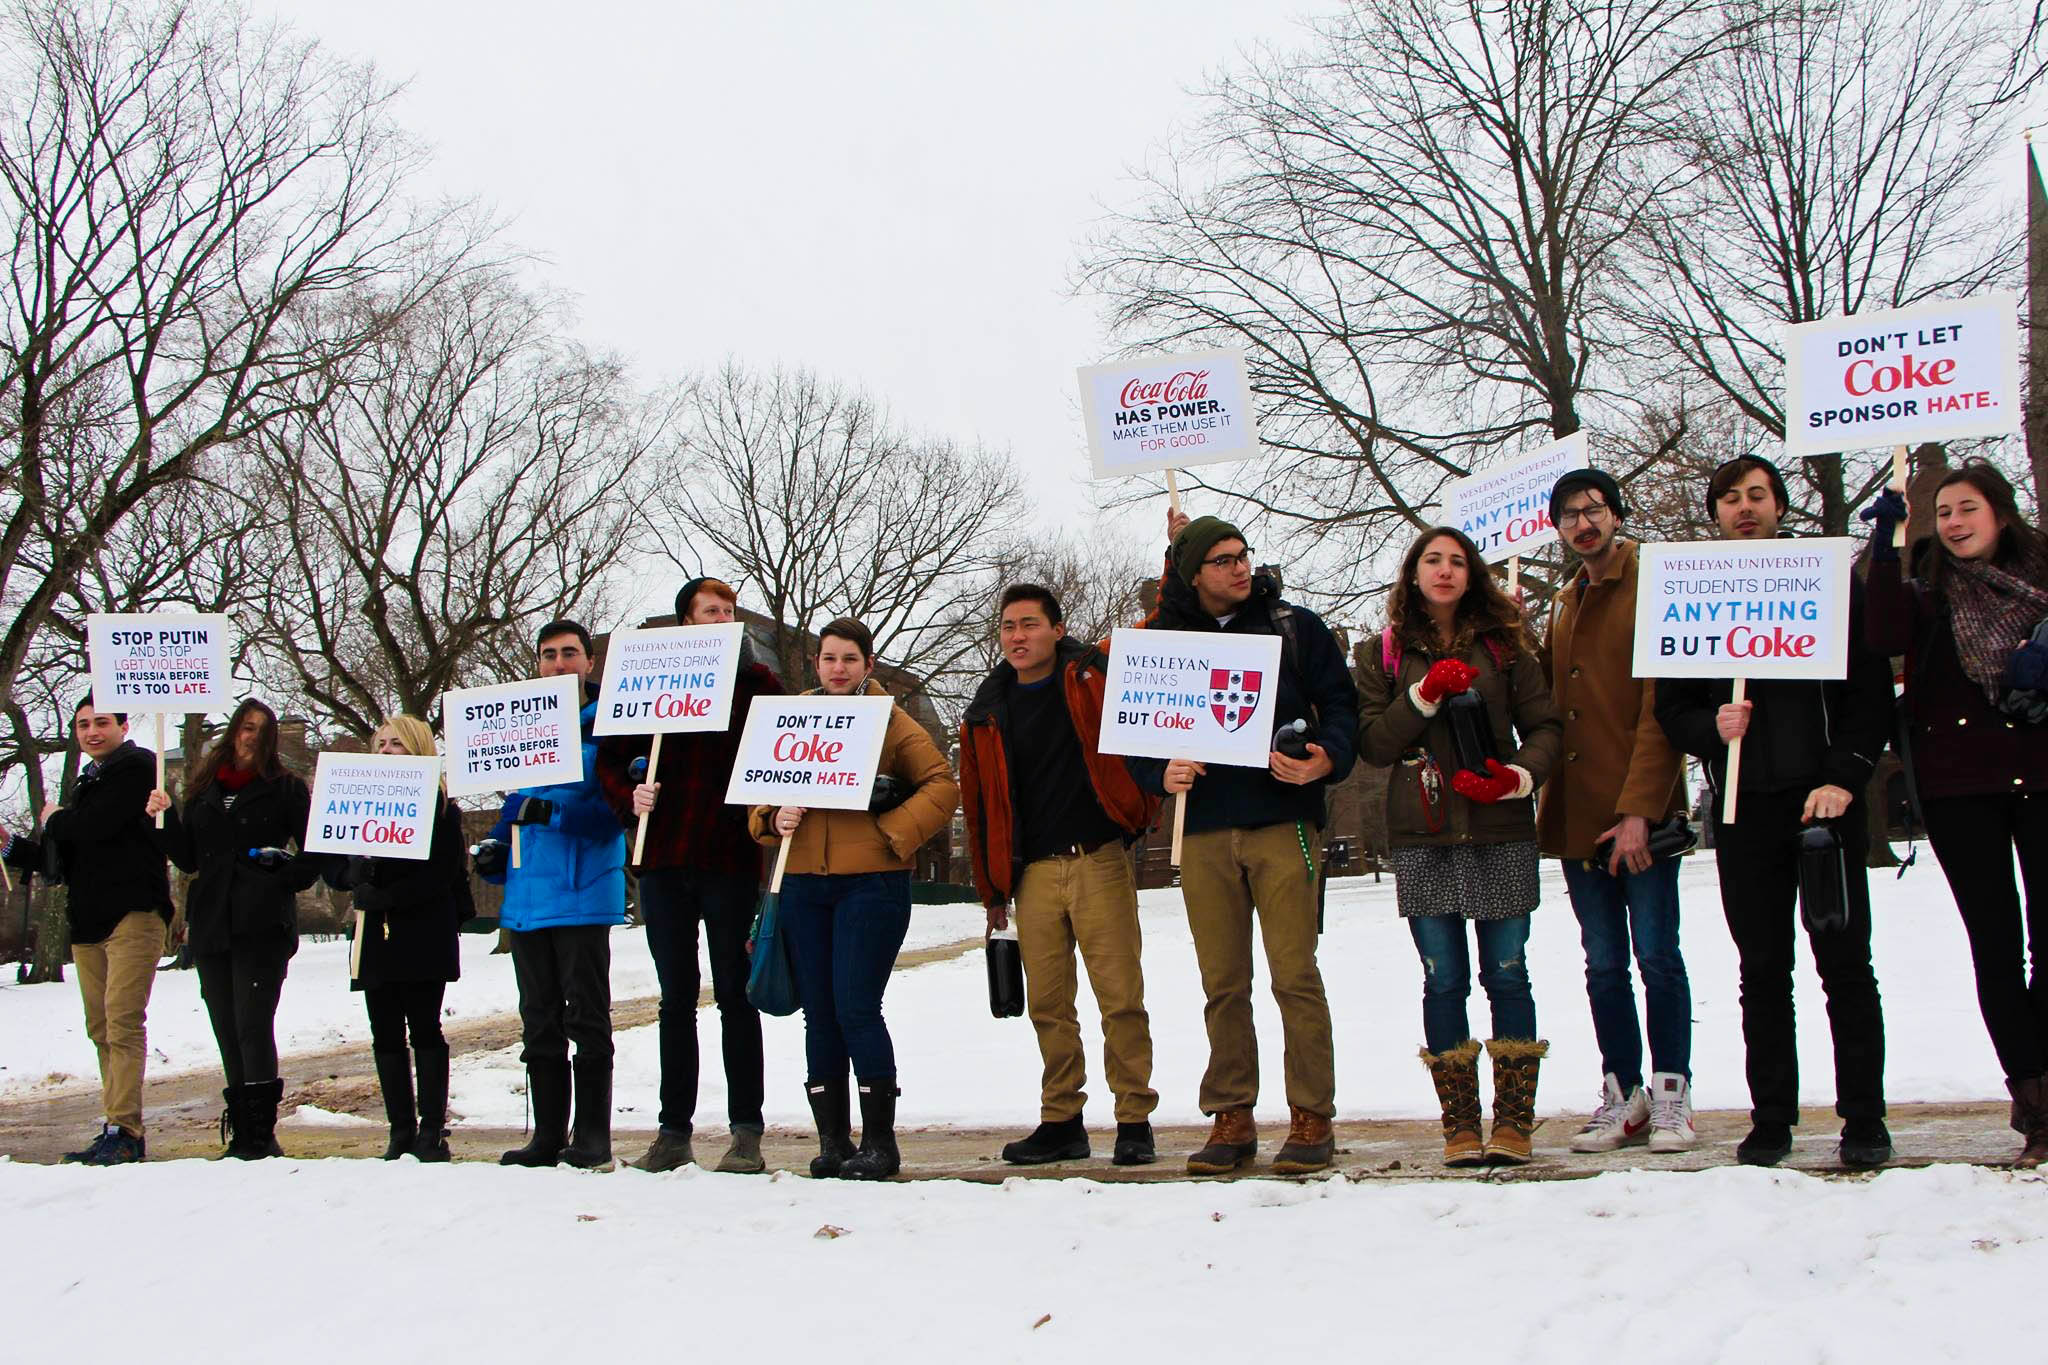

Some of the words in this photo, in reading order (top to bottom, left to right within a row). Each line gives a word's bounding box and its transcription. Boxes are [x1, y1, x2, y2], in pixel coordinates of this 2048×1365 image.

[1837, 332, 1909, 357] DON'T
[1918, 325, 1963, 346] LET
[1844, 354, 1956, 397] Coke
[1115, 409, 1152, 425] HAS
[1157, 400, 1226, 420] POWER.
[1809, 400, 1918, 428] SPONSOR
[1927, 391, 1999, 414] HATE.
[1113, 426, 1149, 441] MAKE
[1152, 421, 1188, 435] THEM
[1191, 417, 1216, 430] USE
[1220, 415, 1231, 426] IT
[1140, 439, 1166, 451] FOR
[1170, 433, 1209, 448] GOOD.
[1459, 477, 1507, 500] WESLEYAN
[1509, 451, 1568, 480] UNIVERSITY
[1460, 483, 1525, 517] STUDENTS
[1528, 466, 1567, 490] DRINK
[1462, 488, 1552, 533] ANYTHIN
[1476, 531, 1502, 553] UT
[1505, 509, 1553, 543] Cok
[1663, 559, 1733, 571] WESLEYAN
[1738, 556, 1823, 569] UNIVERSITY
[1663, 578, 1758, 594] STUDENTS
[1764, 577, 1822, 592] DRINK
[1662, 600, 1818, 622] ANYTHING
[111, 631, 153, 645] STOP
[160, 631, 208, 644] PUTIN
[624, 641, 668, 653] WESLEYAN
[670, 639, 723, 650] UNIVERSITY
[1660, 636, 1722, 656] BUT
[1726, 625, 1816, 658] Coke
[129, 646, 155, 657] AND
[160, 646, 192, 657] STOP
[114, 659, 145, 670] LGBT
[149, 658, 209, 670] VIOLENCE
[621, 656, 681, 671] STUDENTS
[683, 655, 721, 667] DRINK
[1126, 655, 1210, 671] WESLEYAN
[116, 672, 126, 680] IN
[130, 672, 166, 680] RUSSIA
[170, 671, 210, 680] BEFORE
[617, 672, 715, 692] ANYTHING
[1123, 672, 1178, 686] DRINKS
[116, 684, 141, 694] IT'S
[144, 684, 170, 694] TOO
[175, 683, 211, 694] LATE.
[465, 702, 505, 721] STOP
[510, 695, 558, 715] PUTIN
[612, 702, 652, 718] BUT
[654, 693, 712, 718] Coke
[1121, 690, 1206, 708] ANYTHING
[481, 717, 506, 731] AND
[510, 713, 542, 728] STOP
[776, 715, 822, 729] DON'T
[825, 715, 855, 729] LET
[1118, 711, 1150, 725] BUT
[1153, 710, 1196, 730] Coke
[467, 732, 496, 747] LGBT
[500, 724, 559, 743] VIOLENCE
[468, 749, 478, 758] IN
[481, 745, 517, 757] RUSSIA
[520, 738, 559, 752] BEFORE
[773, 732, 843, 763] Coke
[468, 760, 492, 773] IT'S
[495, 757, 520, 769] TOO
[524, 752, 560, 766] LATE.
[330, 768, 372, 777] WESLEYAN
[374, 770, 424, 779] UNIVERSITY
[744, 770, 812, 784] SPONSOR
[816, 771, 860, 786] HATE.
[328, 784, 385, 795] STUDENTS
[387, 785, 422, 797] DRINK
[326, 800, 417, 817] ANYTHING
[322, 824, 360, 840] BUT
[362, 819, 415, 844] Coke
